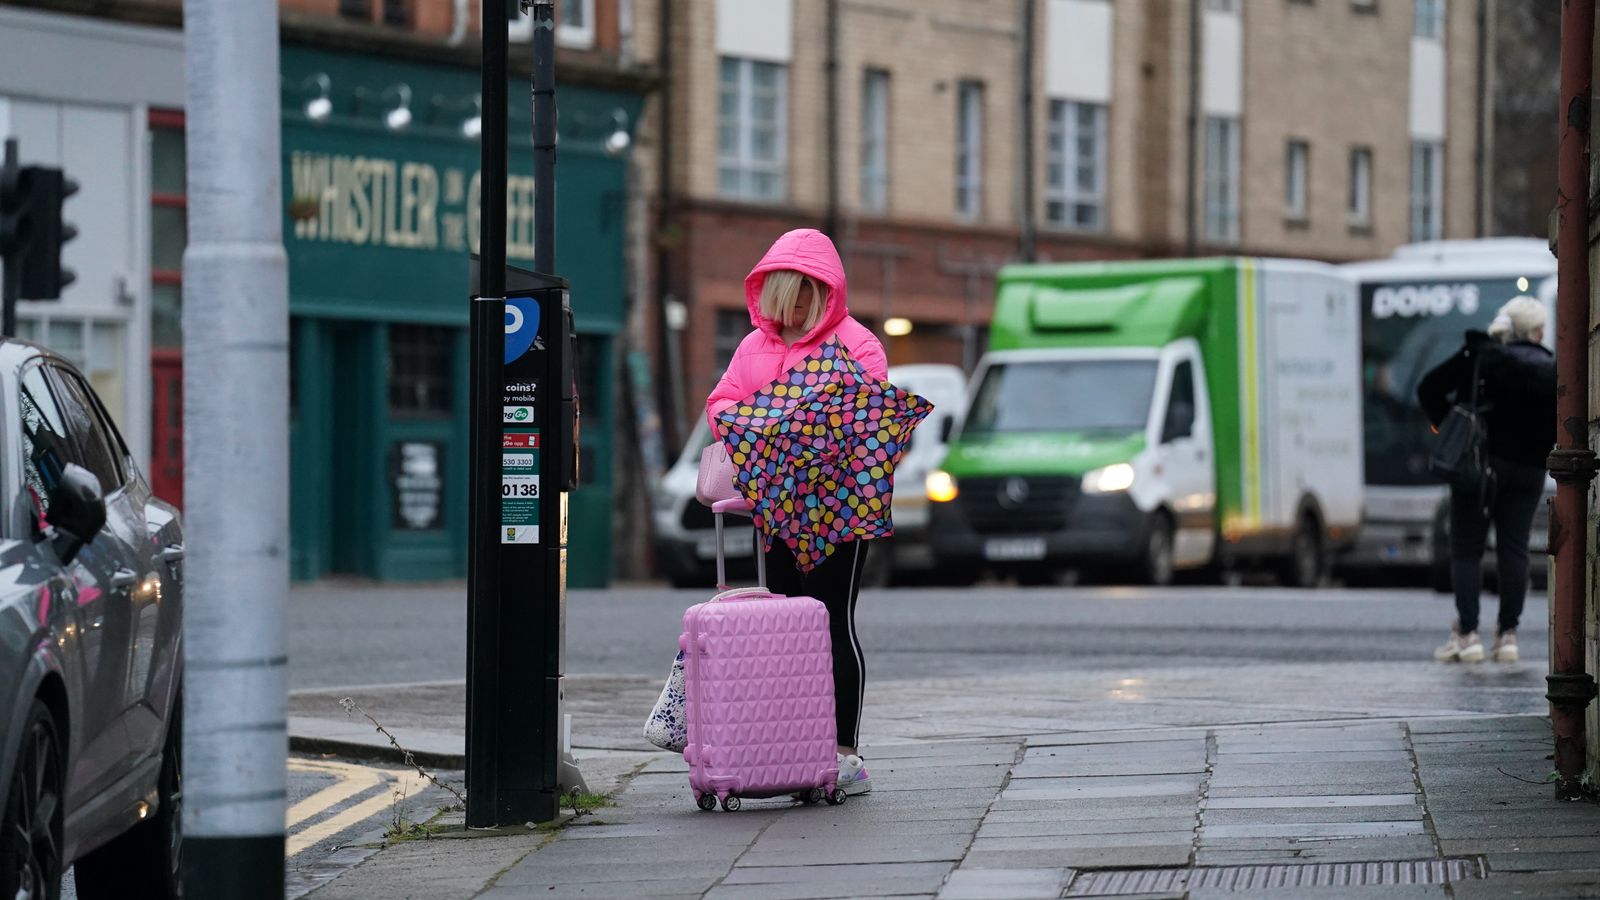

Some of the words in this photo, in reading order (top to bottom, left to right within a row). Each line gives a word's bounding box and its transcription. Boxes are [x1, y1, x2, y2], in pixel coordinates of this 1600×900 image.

[291, 150, 439, 249] WHISTLER
[506, 383, 536, 391] coins?
[502, 484, 537, 496] 0138
